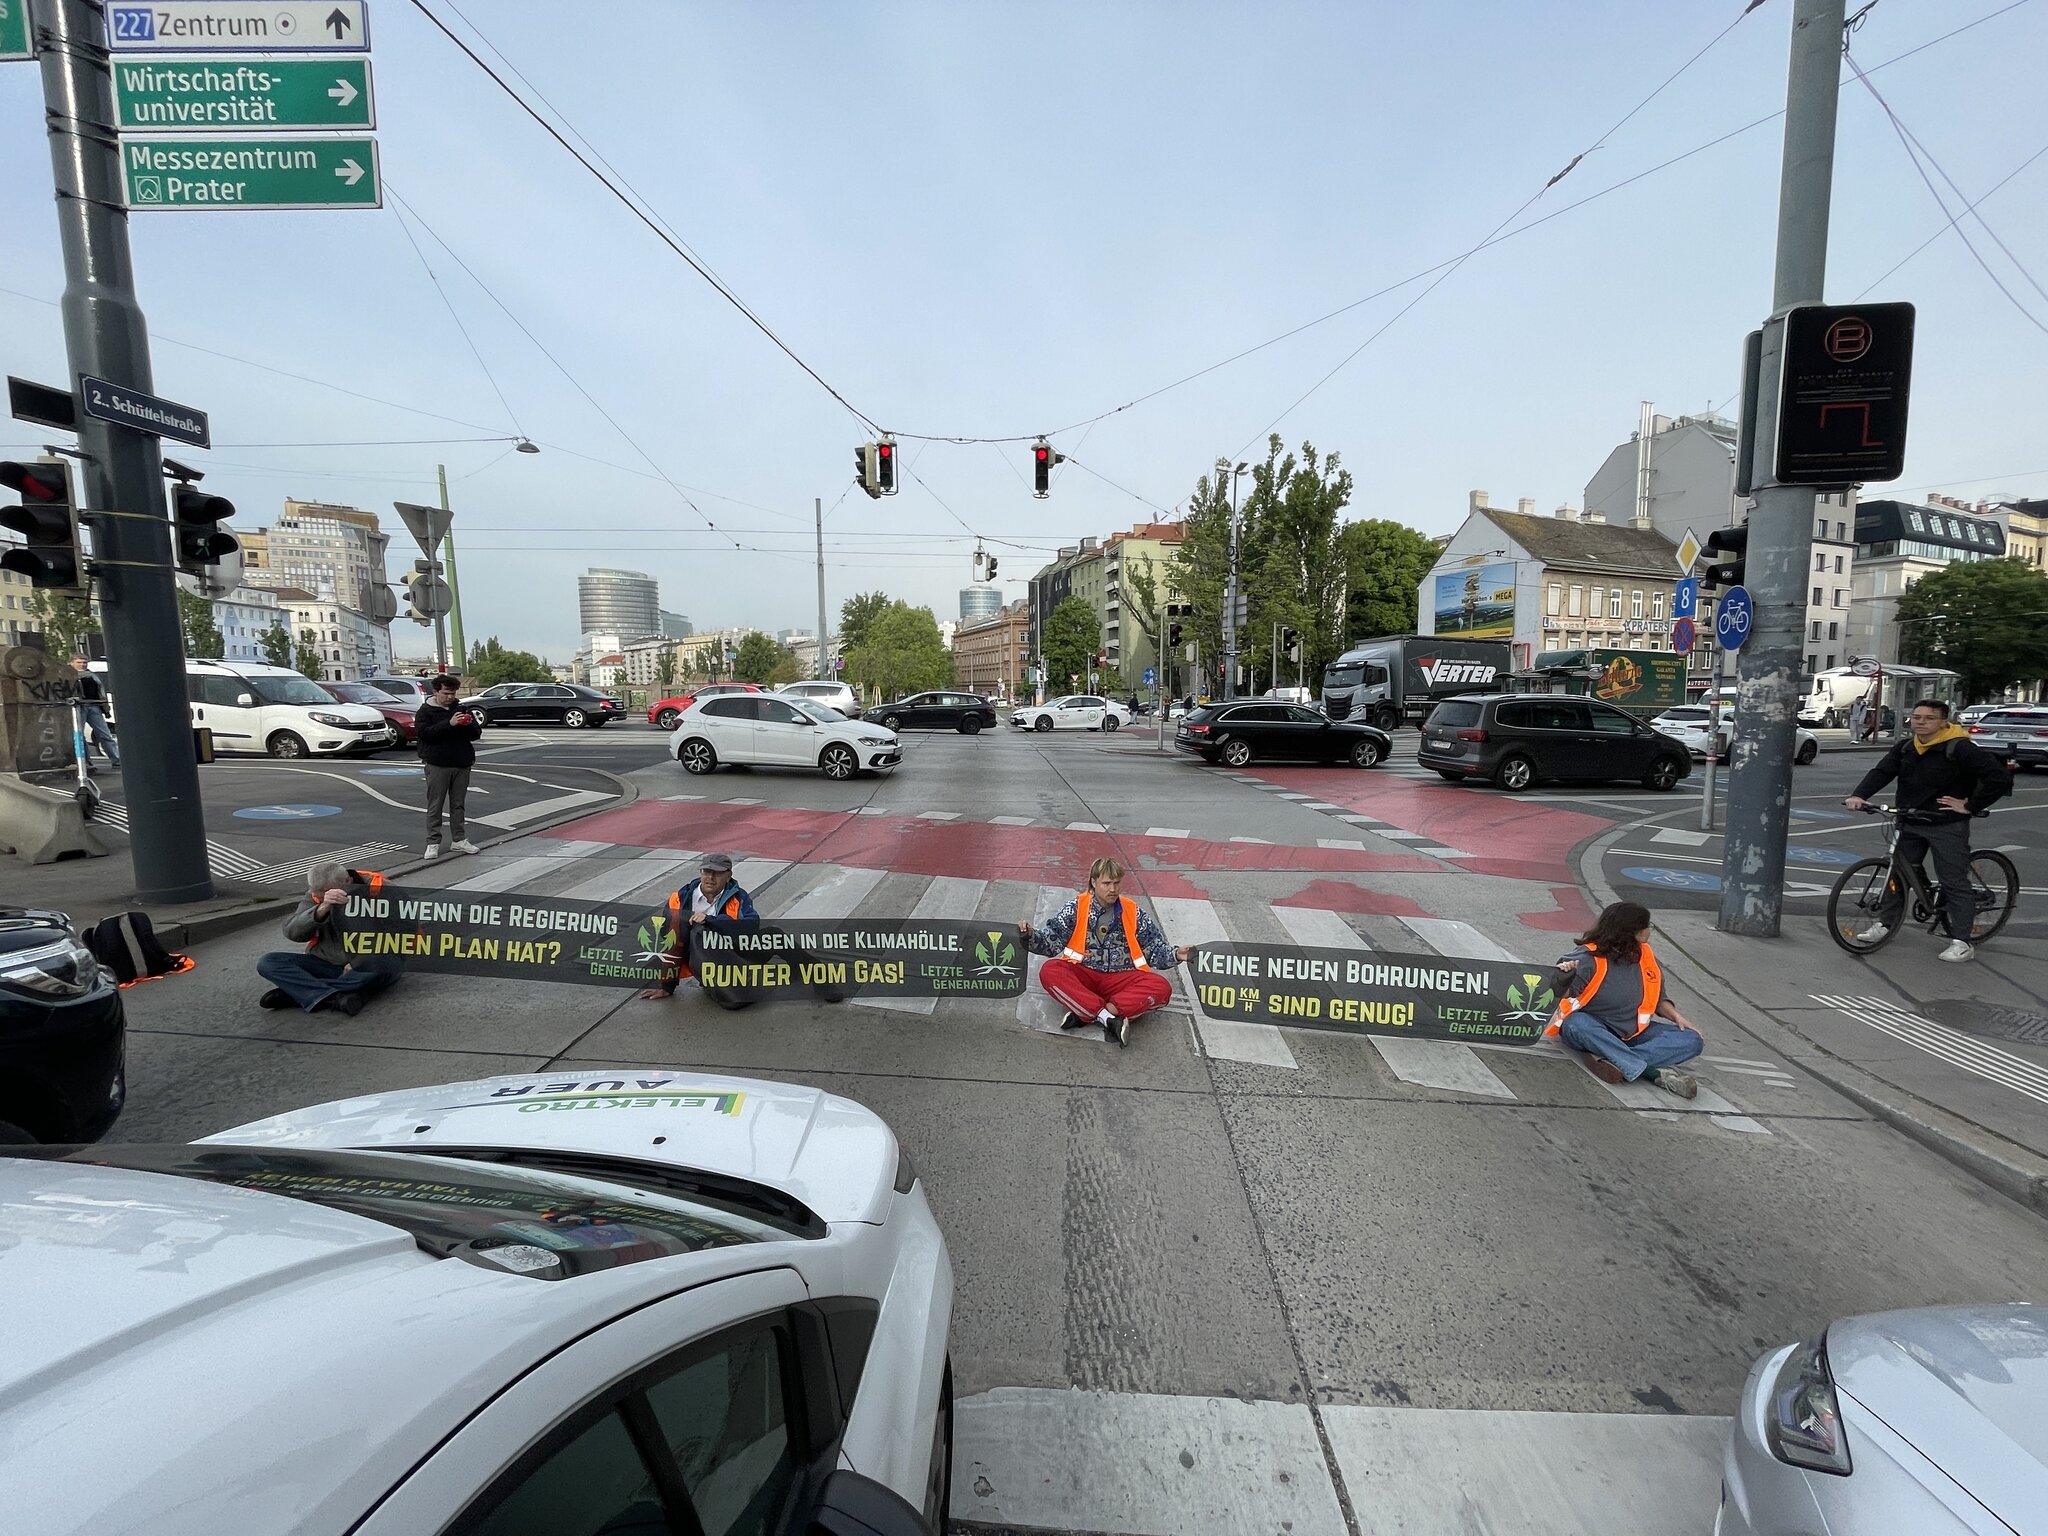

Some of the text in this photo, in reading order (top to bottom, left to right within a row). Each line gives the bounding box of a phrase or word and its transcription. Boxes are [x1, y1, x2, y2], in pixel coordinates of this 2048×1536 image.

[116, 12, 268, 37] 227 Zentrum
[123, 67, 281, 92] Wirtschafts-
[135, 96, 277, 122] universität
[131, 146, 317, 171] Messezentrum
[168, 177, 246, 201] Prater
[111, 395, 202, 435] Schüttelstraße
[1495, 591, 1513, 601] MEGA
[1681, 587, 1690, 609] 8
[1421, 659, 1497, 687] VERTER
[344, 895, 618, 936] UND WENN DIE REGIERUNG
[343, 931, 561, 965] KEINEN PLAN HAT?
[702, 930, 964, 952] WIR RASEN IN DIE KLIMAHÖLLE.
[580, 945, 624, 962] LETZTE
[590, 962, 680, 980] GENERATION.AT
[702, 960, 904, 988] RUNTER VOM GAS!
[921, 963, 964, 977] LETZTE
[1198, 950, 1489, 996] KEINE NEUEN BOHRUNGEN!
[933, 977, 1021, 991] GENERATION.AT
[1199, 984, 1236, 1009] 100
[1268, 994, 1321, 1018] SIND
[1329, 998, 1415, 1028] GENUG!
[1437, 1005, 1489, 1023] LETZTE
[1449, 1021, 1546, 1037] GENERATION.A
[490, 1079, 674, 1097] AUER
[517, 1098, 707, 1113] ELEKTRO
